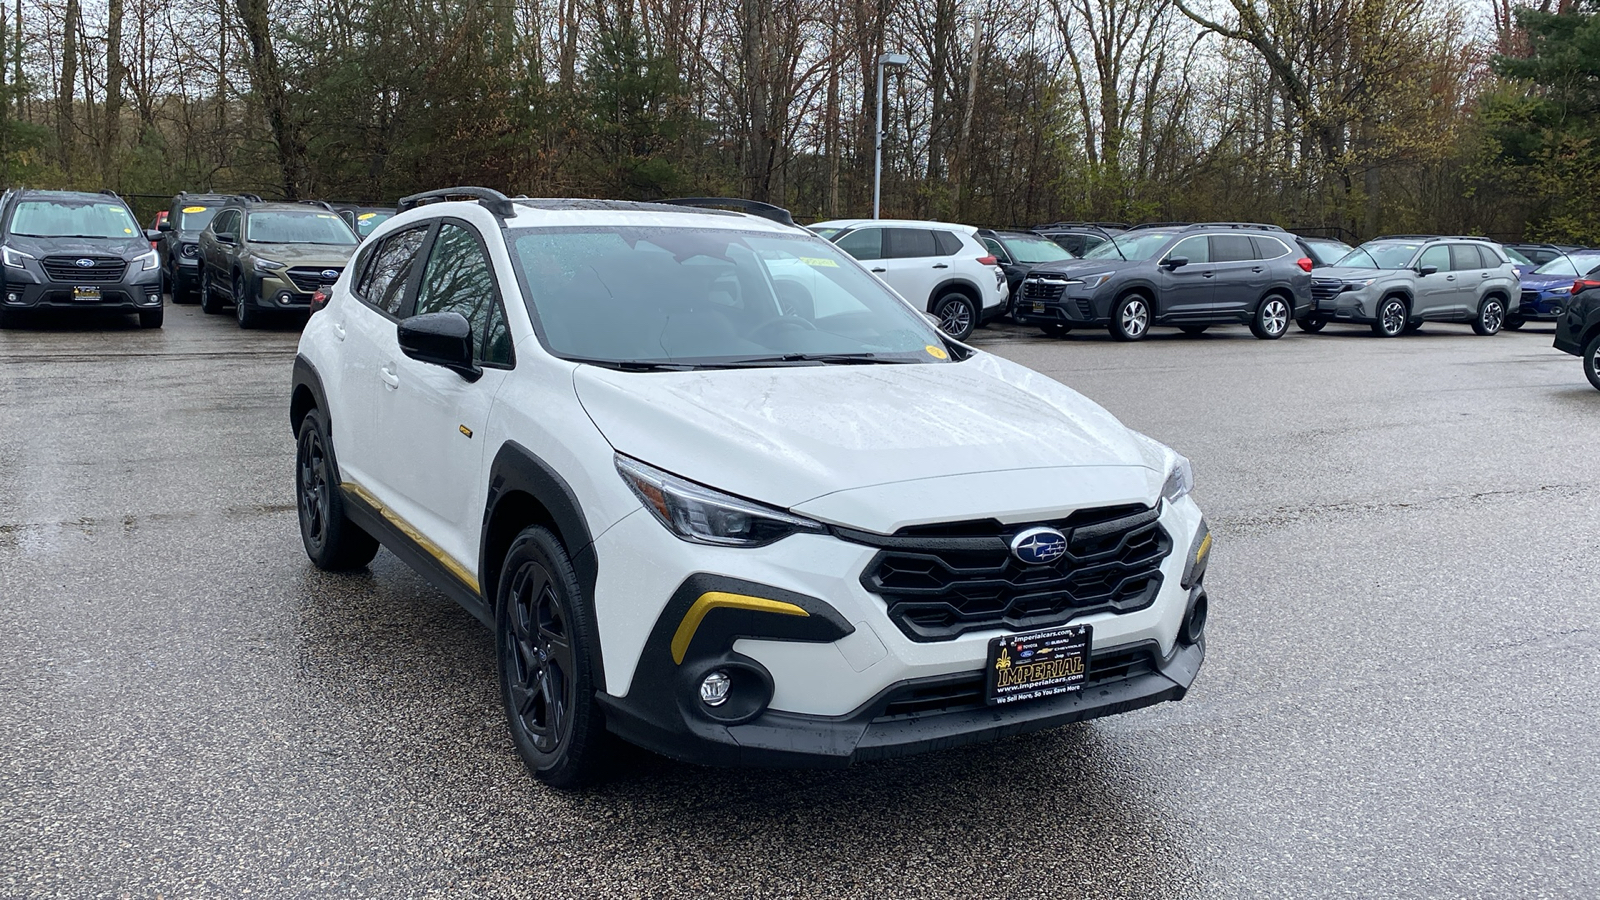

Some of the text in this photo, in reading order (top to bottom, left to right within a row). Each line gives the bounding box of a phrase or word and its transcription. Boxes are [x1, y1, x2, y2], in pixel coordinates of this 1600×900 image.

[1014, 629, 1072, 643] Imperialcars.com
[1054, 642, 1086, 652] CHEVROLET
[997, 656, 1085, 687] IMPERIAL
[996, 674, 1084, 693] www.imperialcars.com
[1007, 695, 1017, 703] Sell
[1066, 684, 1081, 692] More
